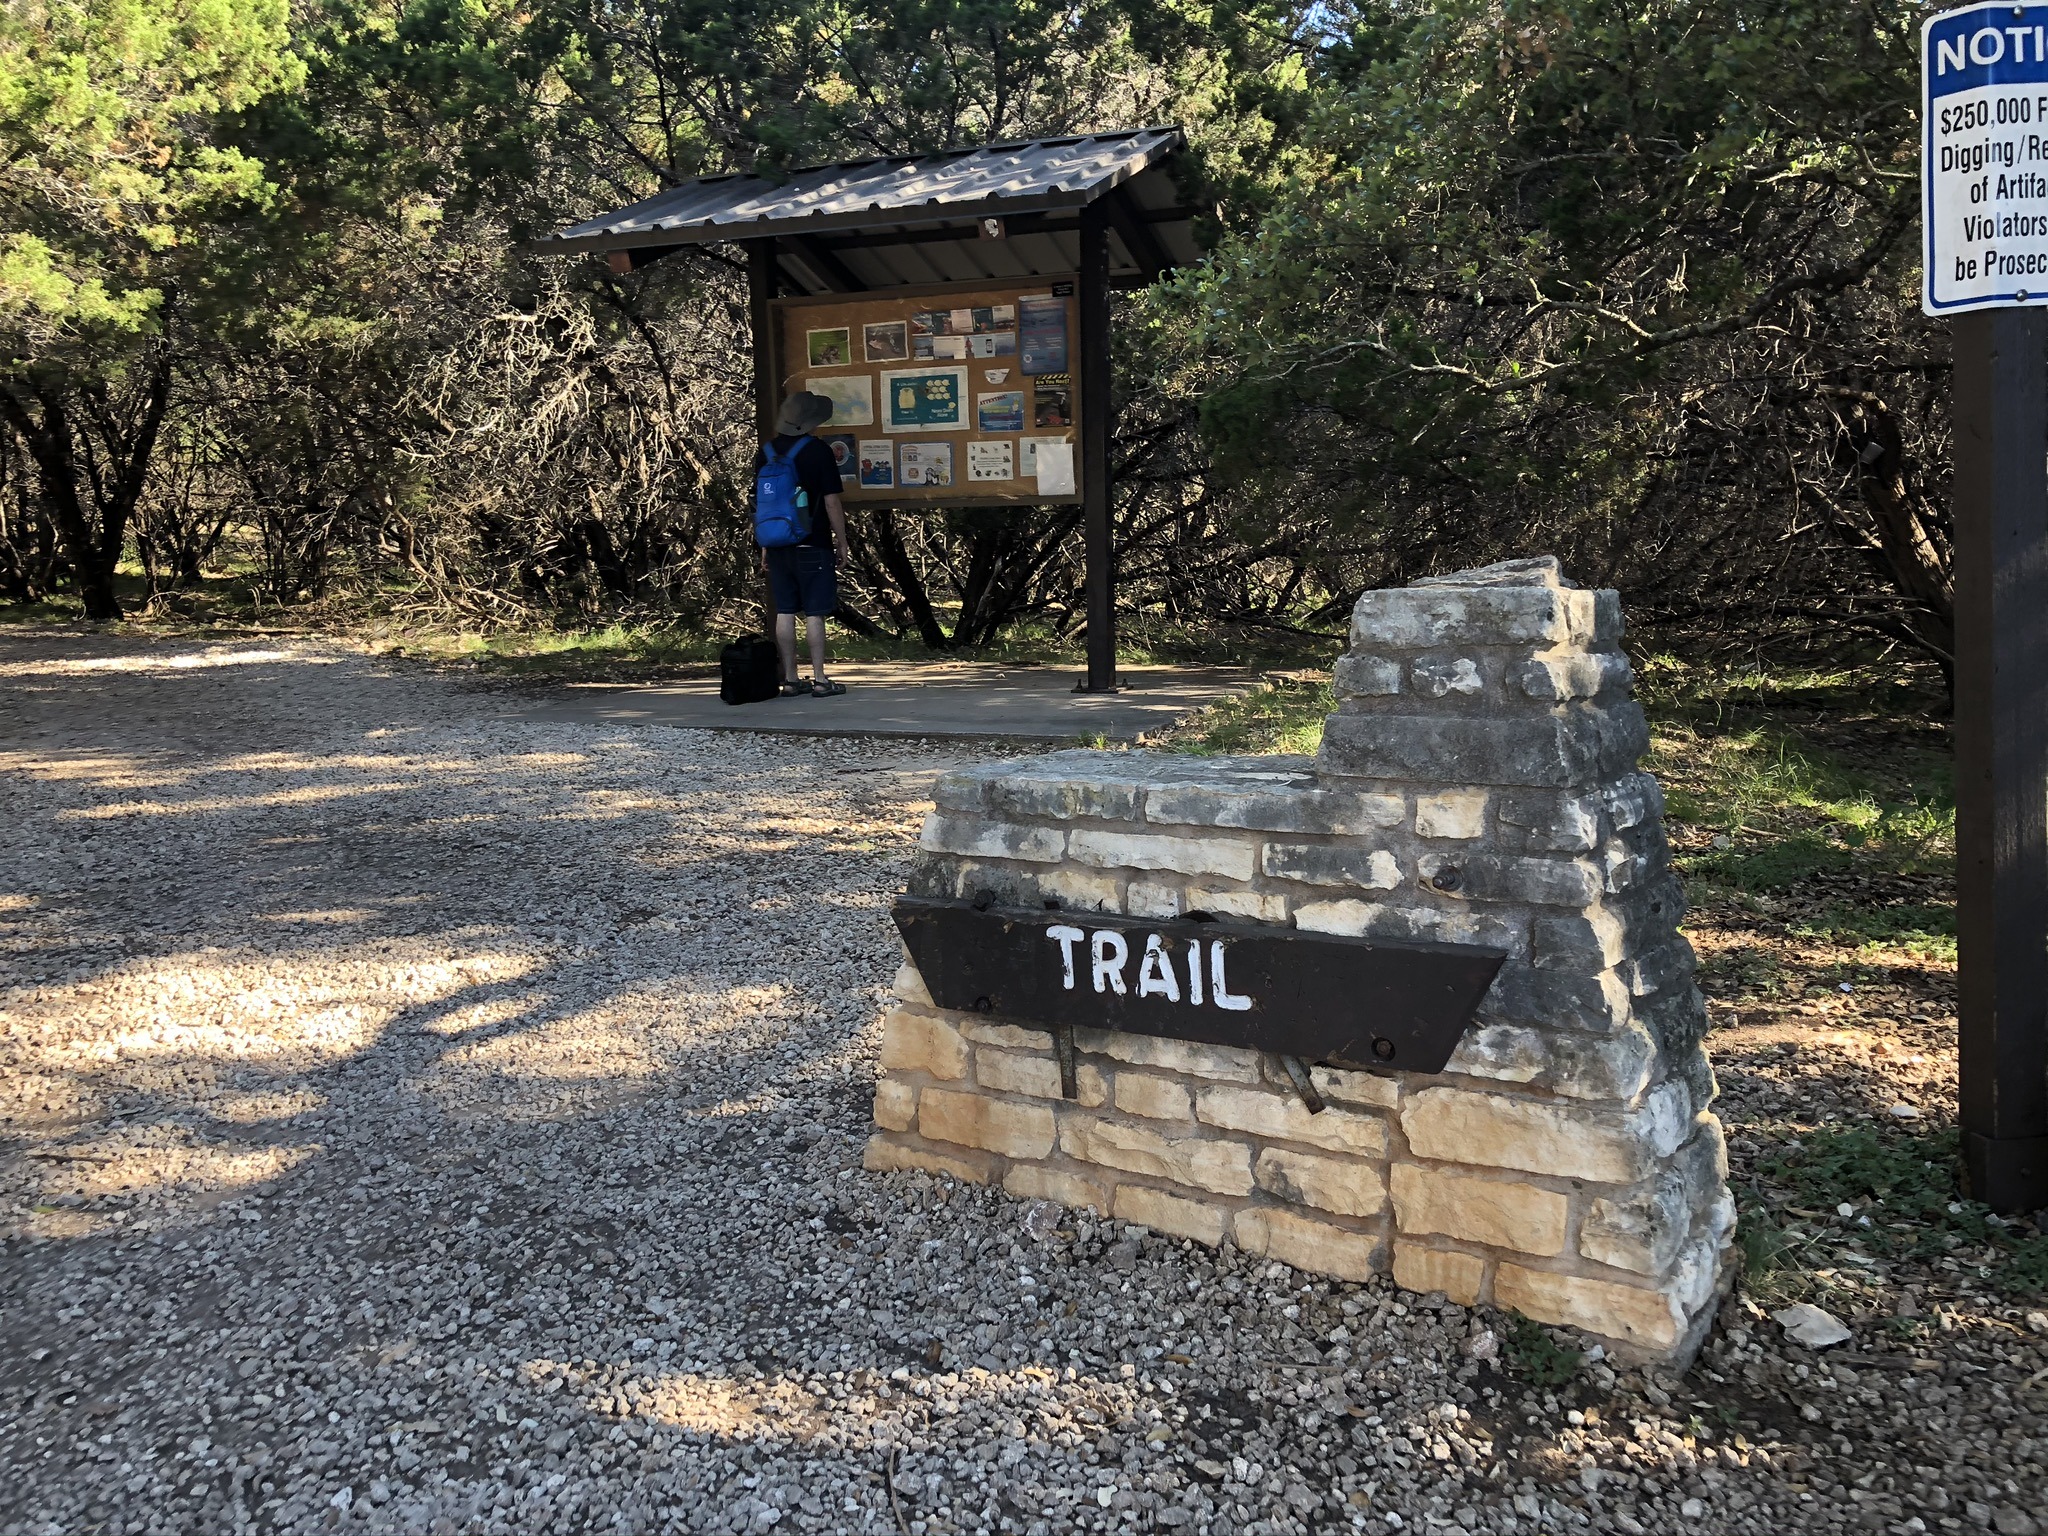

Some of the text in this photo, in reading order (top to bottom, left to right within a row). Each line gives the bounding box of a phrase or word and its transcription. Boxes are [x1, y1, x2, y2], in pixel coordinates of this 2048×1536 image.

[1937, 26, 2048, 76] NOTI
[1941, 97, 2047, 137] $250,000 F
[1970, 172, 2048, 204] of Artifa
[1964, 212, 2047, 242] Violators
[1955, 250, 2047, 282] be Prosec
[1046, 925, 1253, 1011] TRAIL
